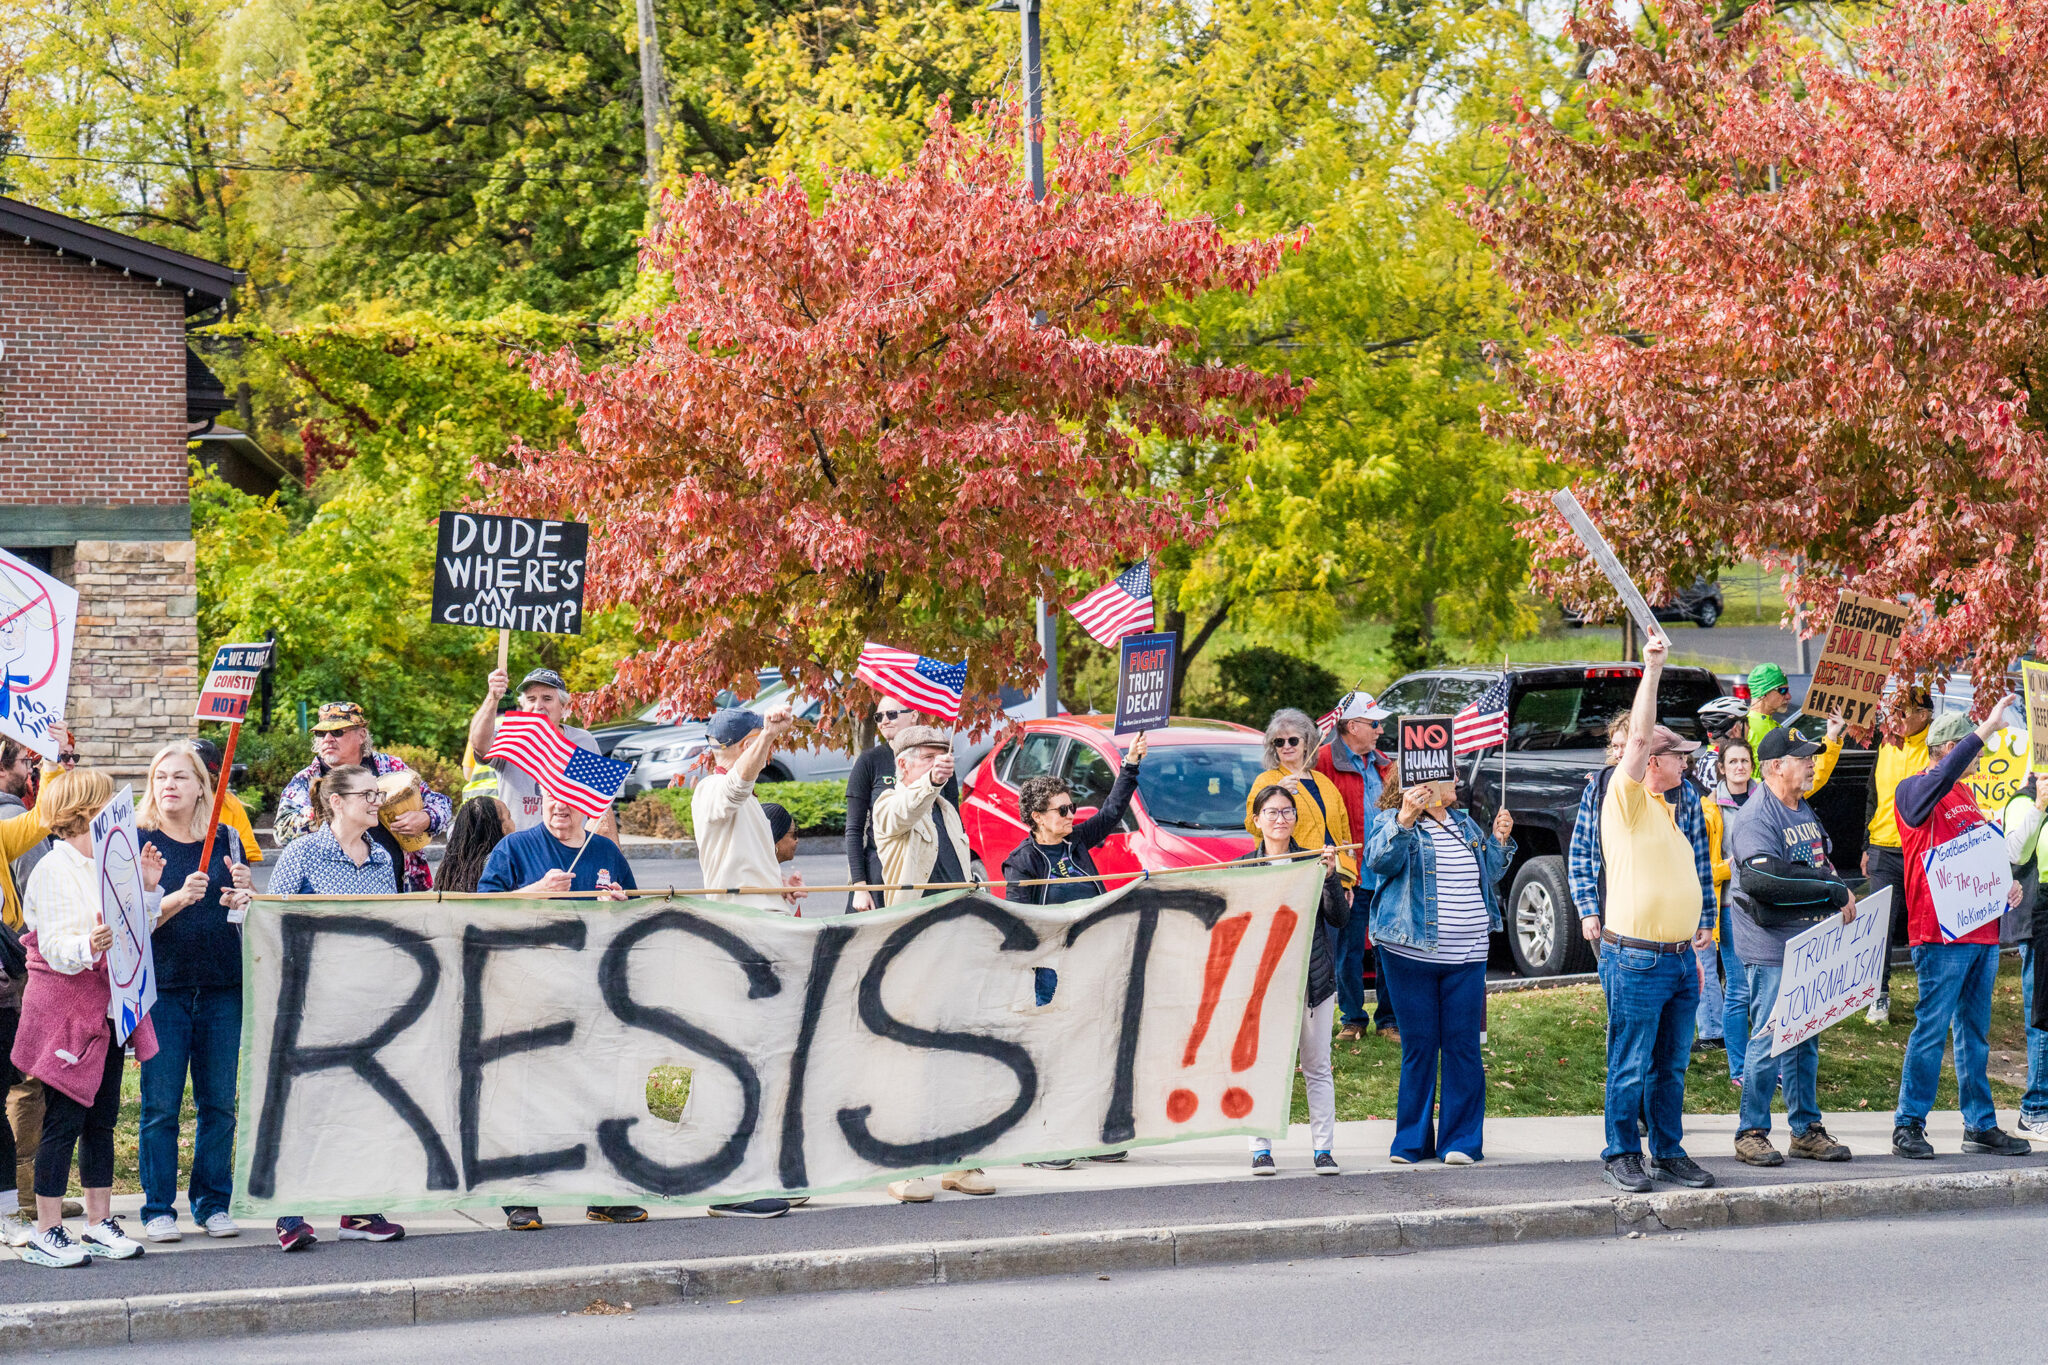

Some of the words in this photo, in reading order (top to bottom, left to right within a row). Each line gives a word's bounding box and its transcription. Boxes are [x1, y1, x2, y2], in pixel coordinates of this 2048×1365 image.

[452, 514, 563, 558] DUDE
[443, 554, 584, 593] WHERE'S
[475, 587, 515, 611] MY
[443, 600, 577, 634] COUNTRY?
[227, 651, 245, 666] WE
[1827, 626, 1893, 666] SMALL
[1129, 649, 1166, 672] FIGHT
[1128, 670, 1164, 693] TRUTH
[1813, 660, 1887, 695] DICTATOR
[16, 694, 47, 714] NO
[211, 697, 236, 713] NOT
[239, 699, 248, 714] A
[1125, 691, 1163, 715] DECAY
[1404, 724, 1448, 750] NO
[1405, 749, 1449, 770] HUMAN
[1405, 772, 1414, 781] IS
[1416, 769, 1449, 781] ILLEGAL
[524, 805, 538, 815] UP
[93, 811, 109, 843] NO
[1936, 866, 1953, 890] We
[1954, 872, 1972, 892] The
[1973, 871, 2002, 897] People
[1988, 900, 2001, 914] Act
[1793, 924, 1845, 978] TRUTH
[1851, 908, 1879, 944] IN
[1781, 937, 1885, 1027] JOURNALISM
[248, 888, 1298, 1199] RESIST!!
